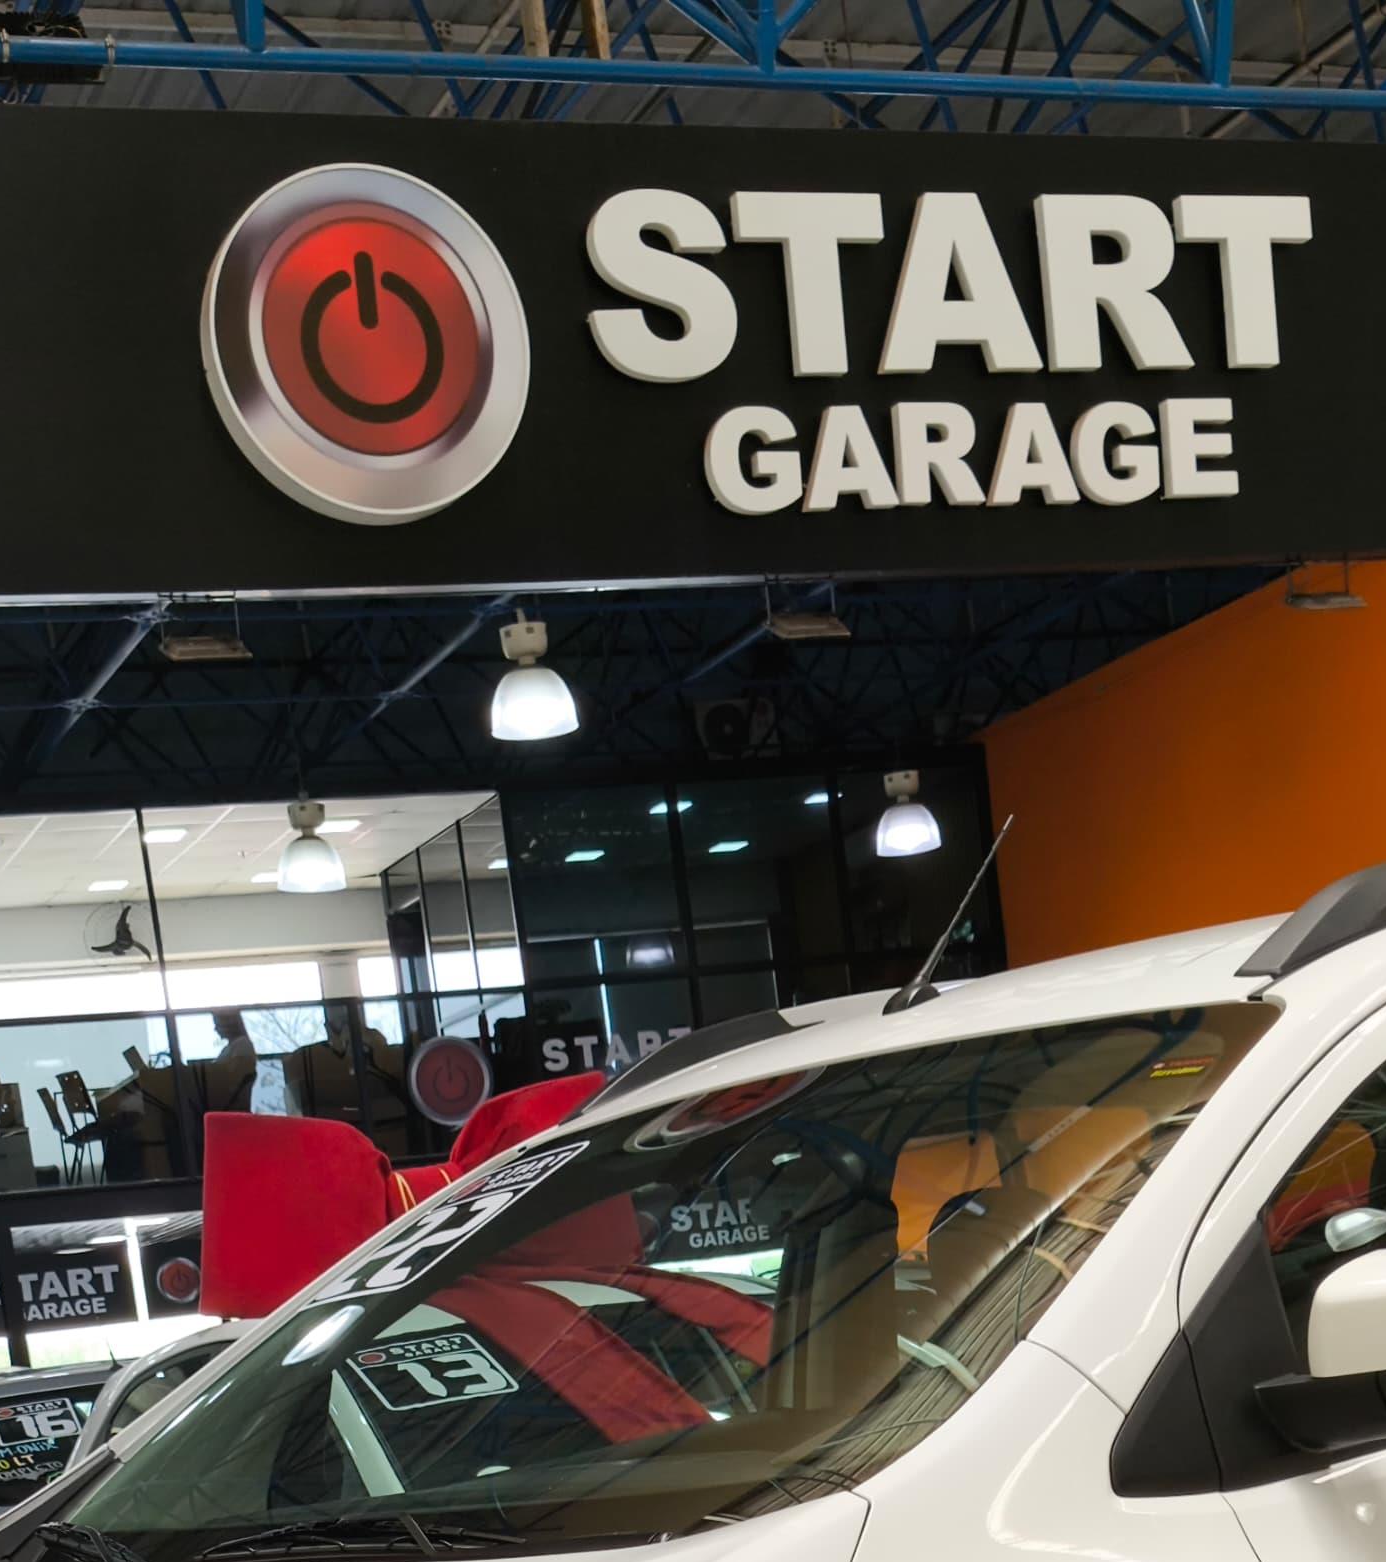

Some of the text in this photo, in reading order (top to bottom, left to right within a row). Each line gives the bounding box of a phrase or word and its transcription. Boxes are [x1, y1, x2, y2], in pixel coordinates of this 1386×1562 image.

[585, 187, 1313, 384] START
[703, 397, 1240, 516] GARAGE
[670, 1198, 752, 1232] STAR
[688, 1224, 771, 1249] GARAGE
[24, 1296, 108, 1322] ARAGE
[388, 1336, 463, 1355] START
[397, 1351, 508, 1398] 13
[15, 1409, 79, 1439] 16
